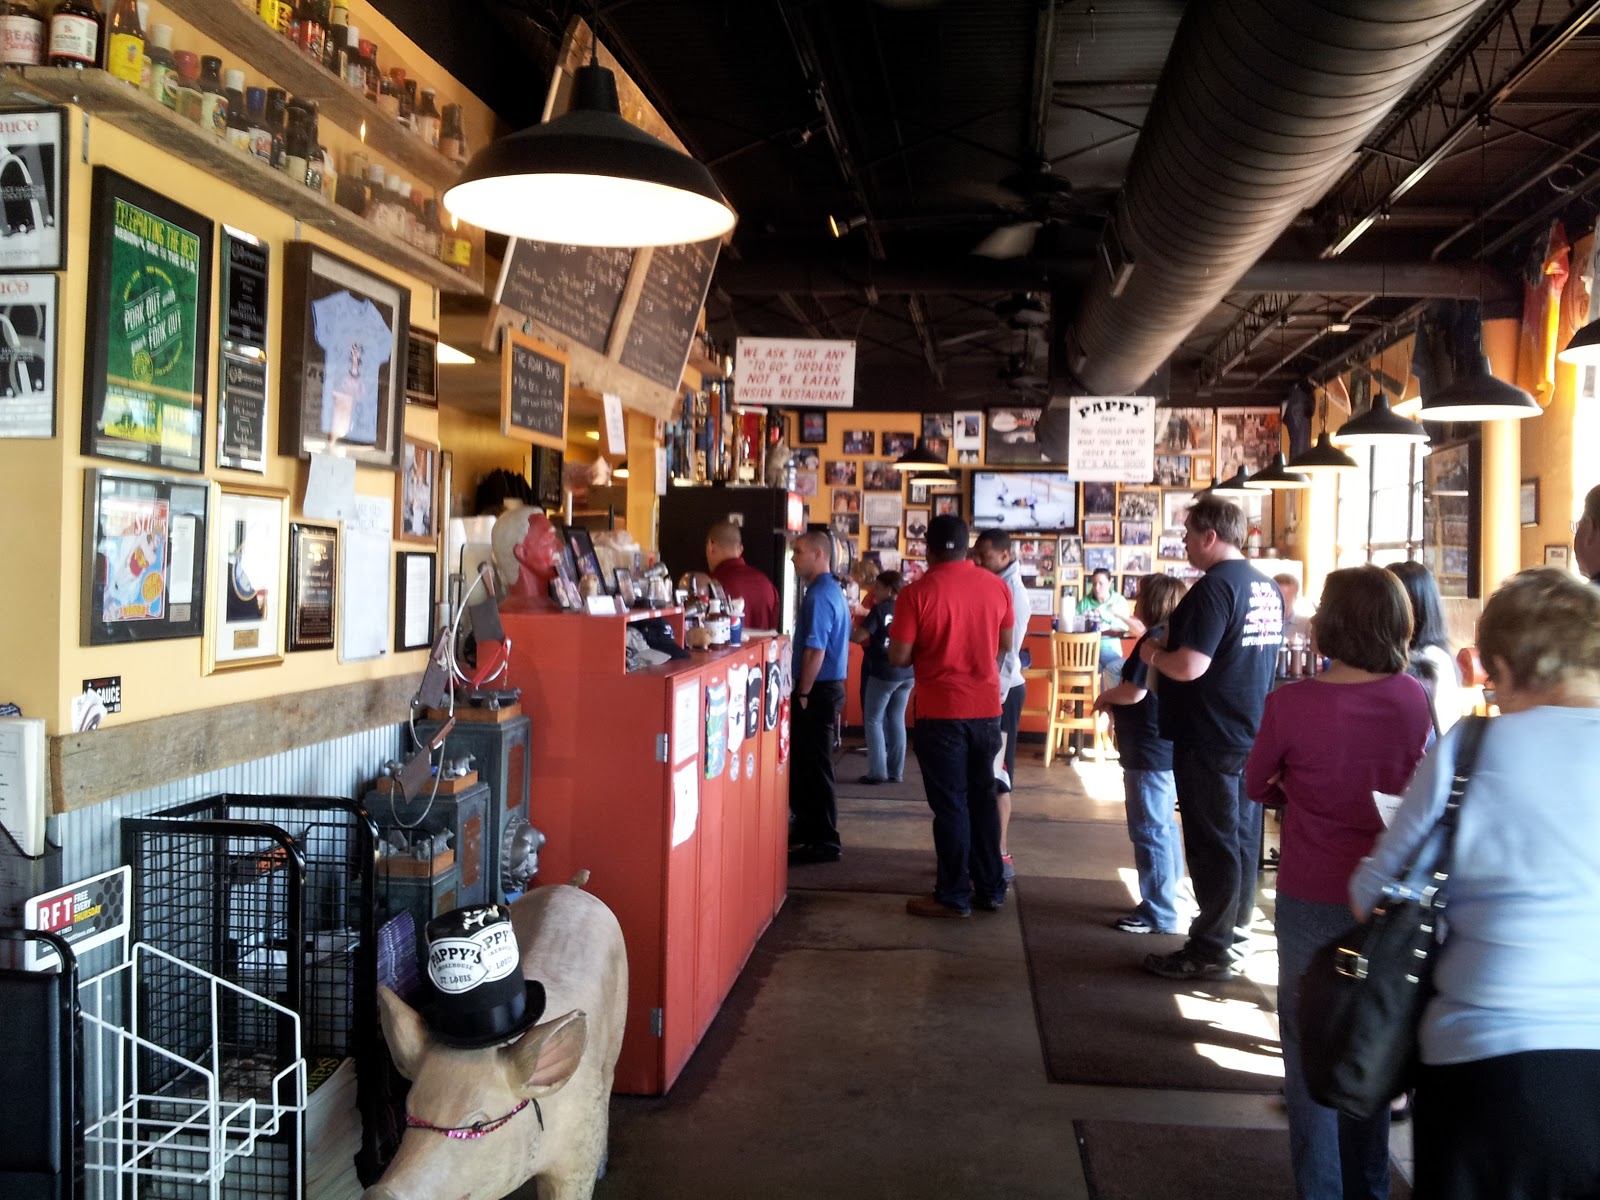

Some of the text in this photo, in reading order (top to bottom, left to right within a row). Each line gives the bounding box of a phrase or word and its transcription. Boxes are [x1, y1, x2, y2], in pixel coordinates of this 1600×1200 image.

[167, 226, 179, 254] THE
[181, 233, 198, 264] BEST
[124, 302, 145, 332] PORK
[145, 291, 160, 317] OUT
[148, 318, 167, 350] FORK
[168, 309, 181, 335] OUT
[743, 347, 847, 360] WE ASK THAT ANY
[794, 361, 842, 374] ORDERS
[747, 373, 841, 386] NOT BE EATEN
[739, 386, 846, 400] INSIDE RESTAURANT
[1078, 401, 1145, 418] PAPPY
[1097, 428, 1122, 436] SHOULD
[1126, 428, 1145, 436] KNOW
[1077, 460, 1146, 469] IT'S ALL GOOD
[97, 686, 120, 704] SAUCE
[40, 890, 89, 930] RFT FREE
[74, 899, 91, 913] EVERY
[74, 905, 102, 923] THURSDAY
[431, 947, 481, 968] PAPPY'S
[450, 975, 472, 984] LOUIS
